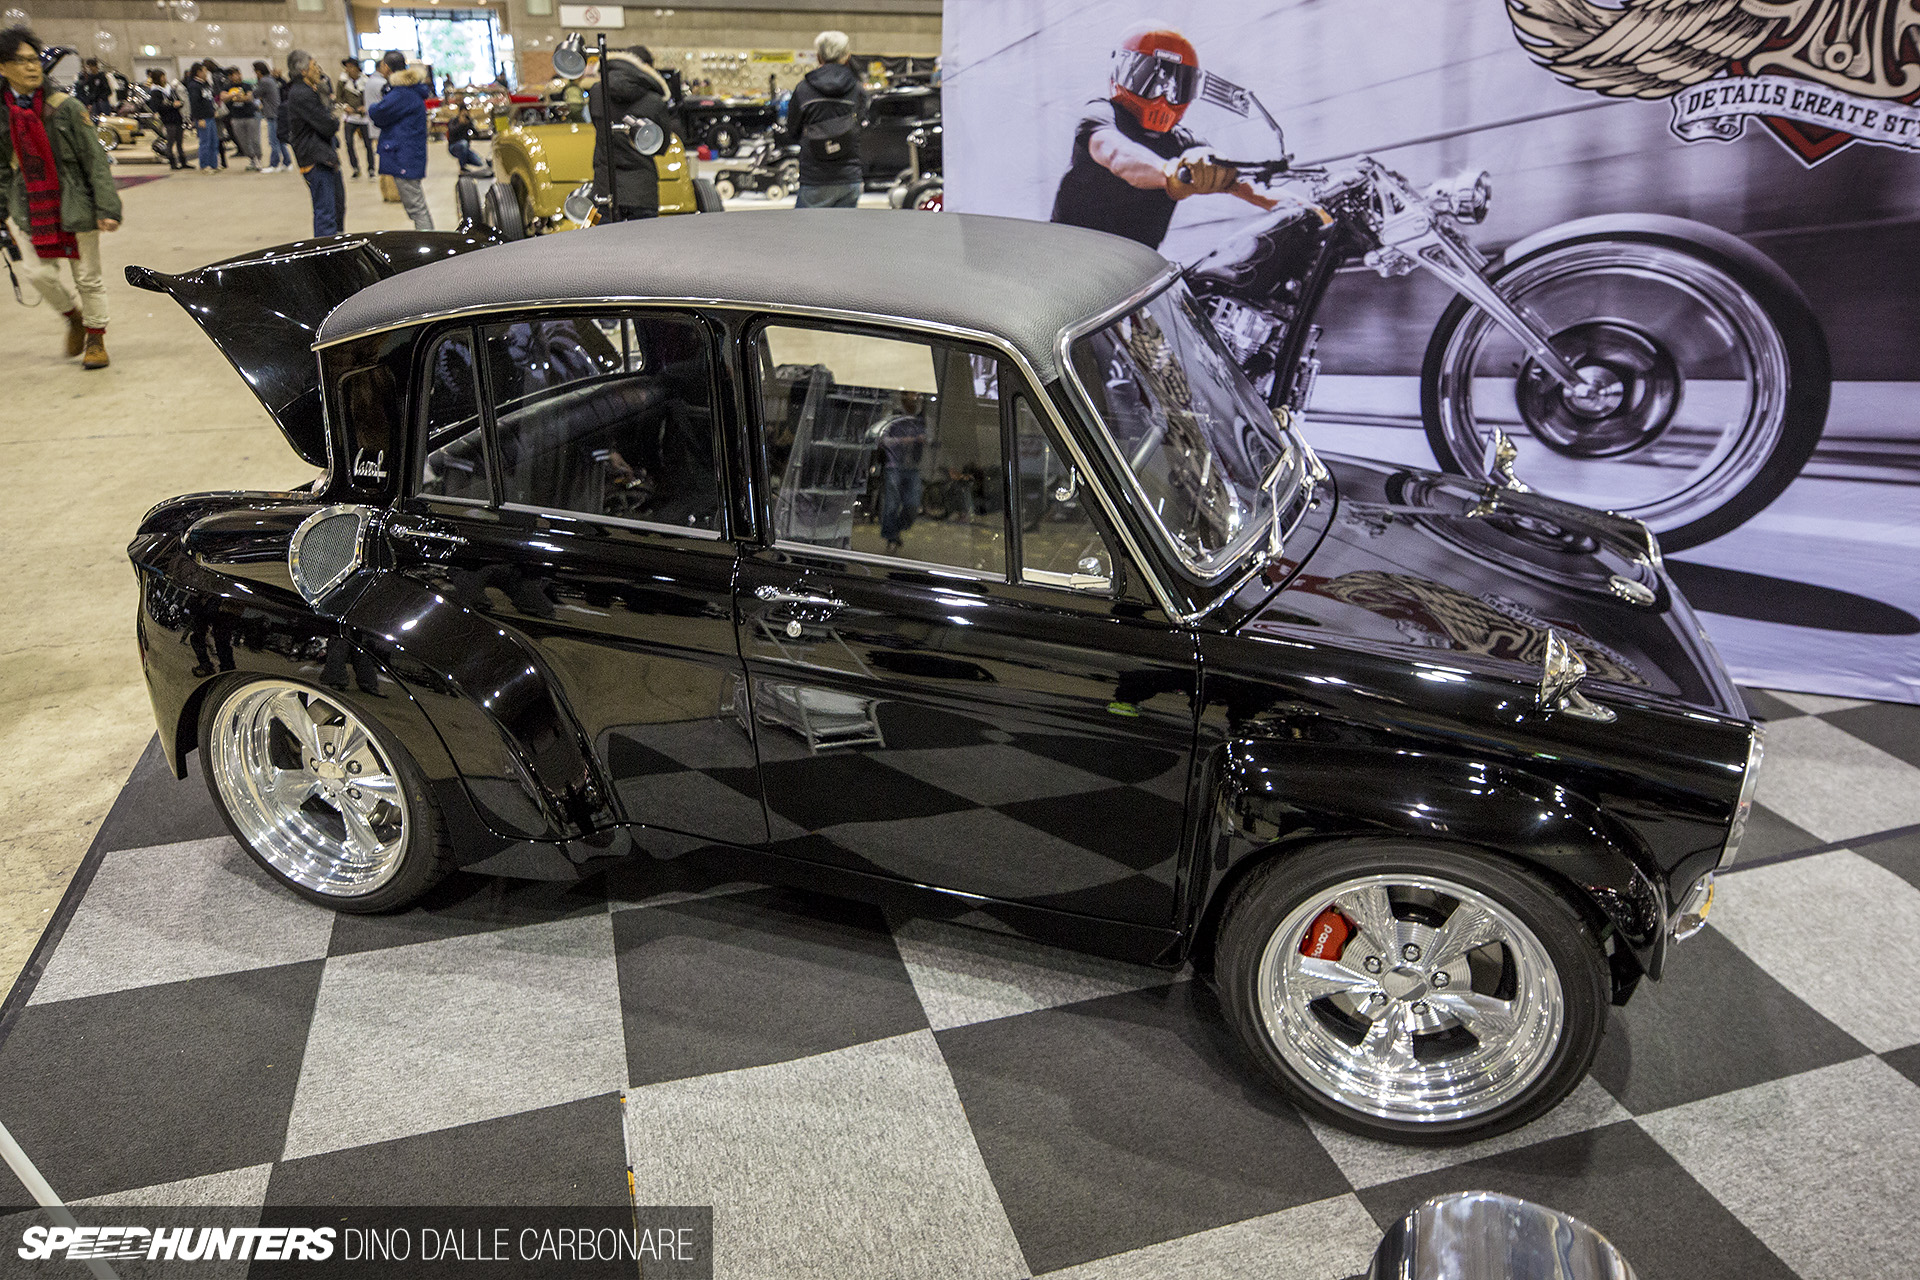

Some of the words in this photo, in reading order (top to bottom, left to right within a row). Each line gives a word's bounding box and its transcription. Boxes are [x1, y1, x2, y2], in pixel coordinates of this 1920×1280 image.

[1686, 83, 1788, 115] DETAILS
[1790, 89, 1879, 129] CREATE
[1883, 114, 1920, 137] ST
